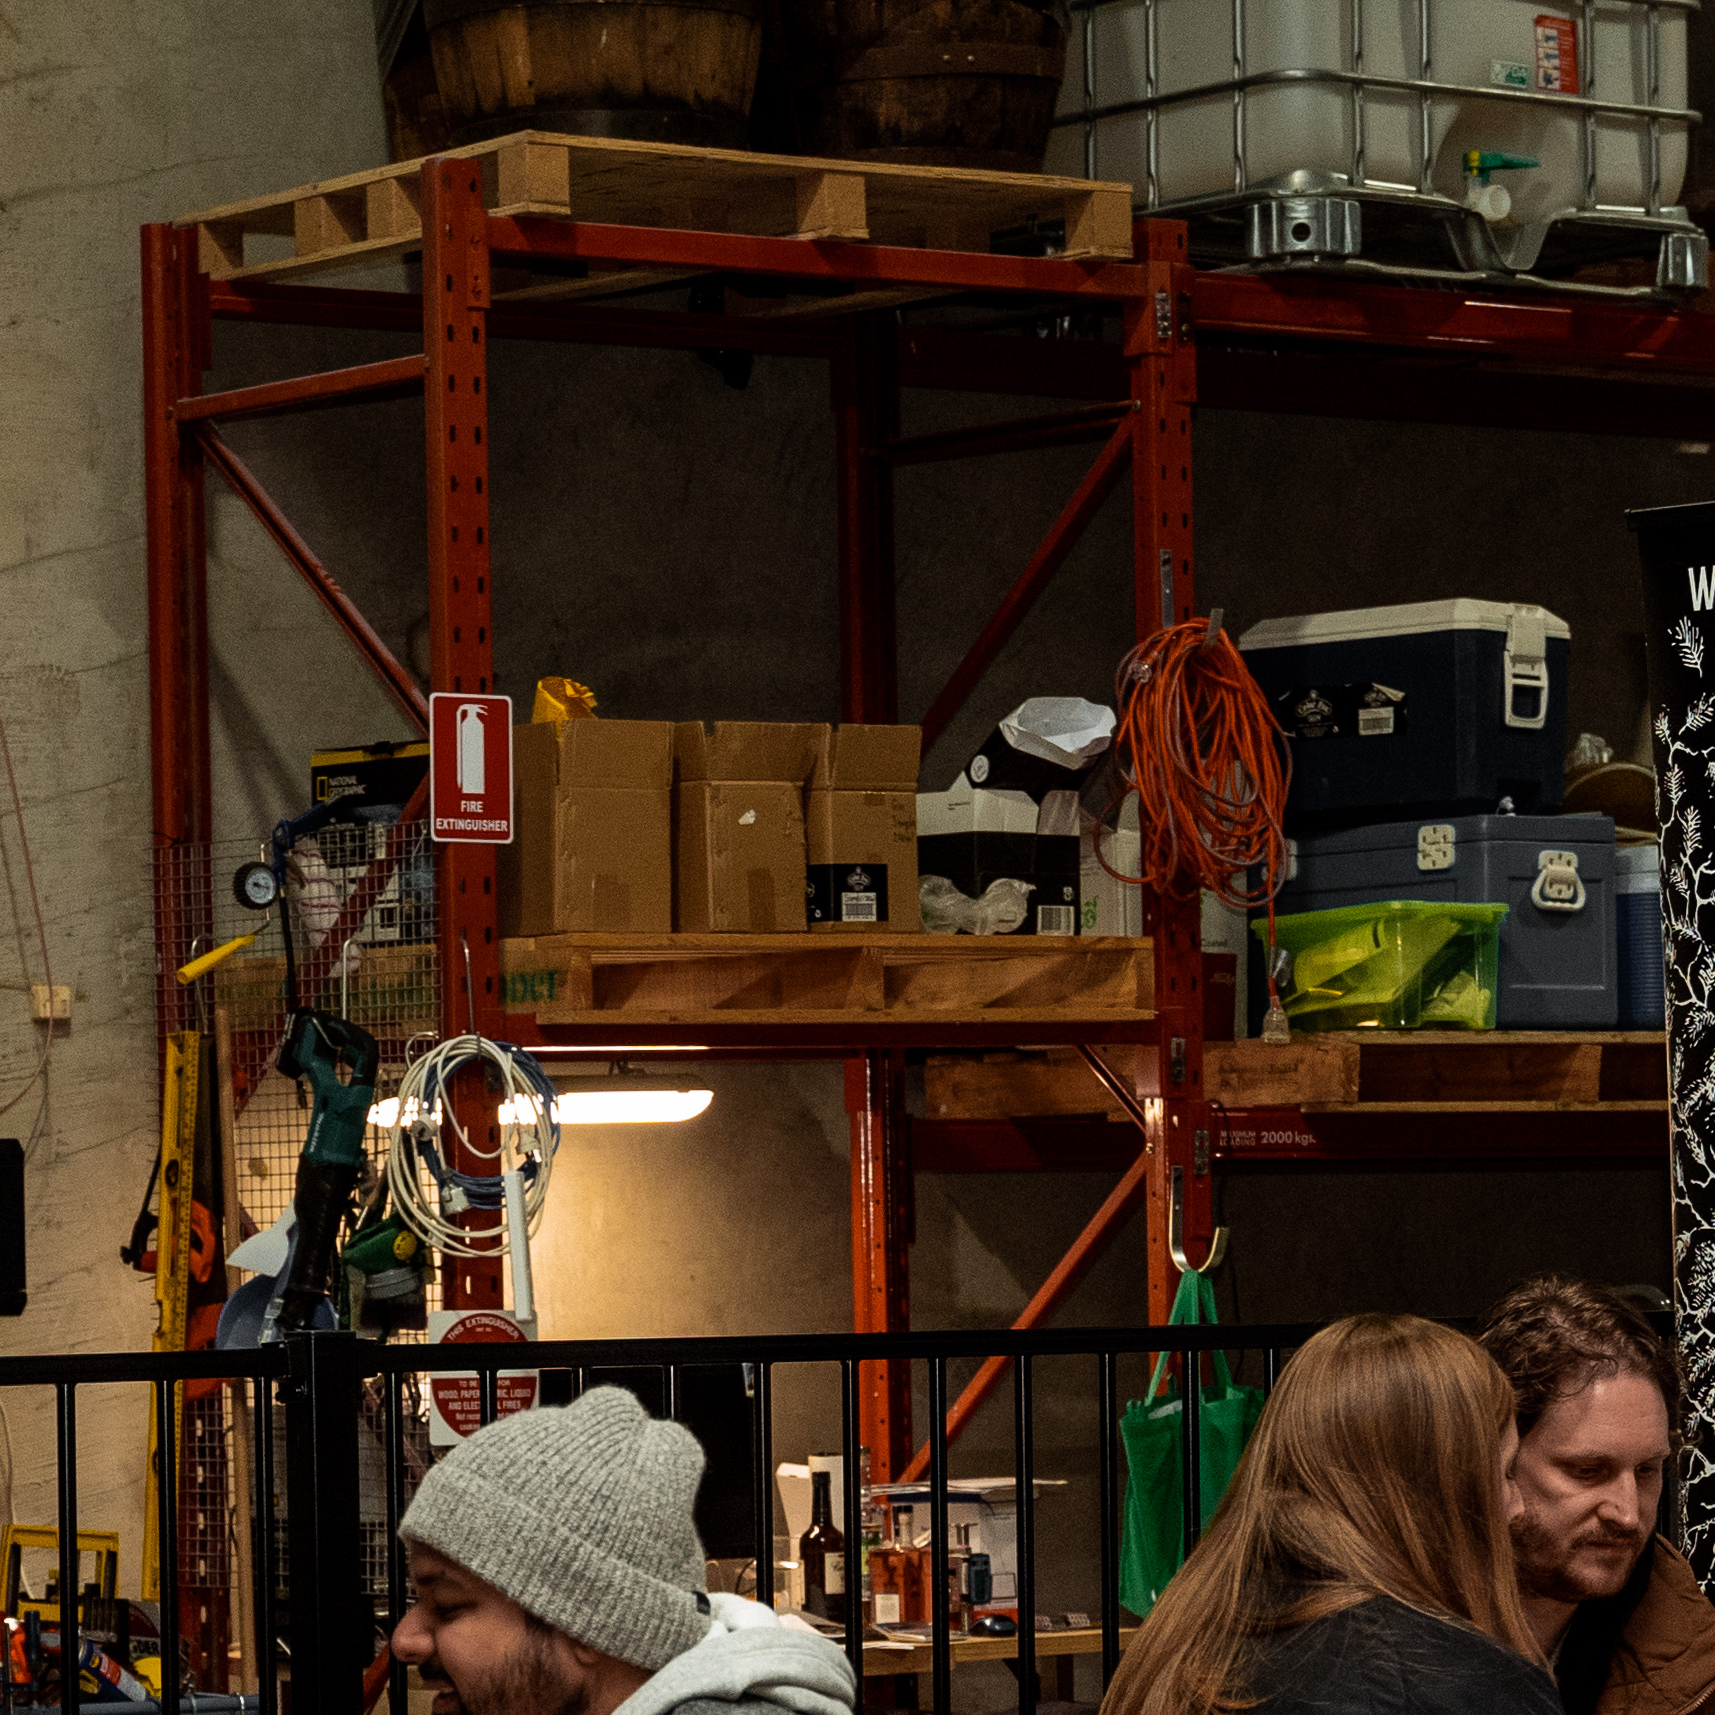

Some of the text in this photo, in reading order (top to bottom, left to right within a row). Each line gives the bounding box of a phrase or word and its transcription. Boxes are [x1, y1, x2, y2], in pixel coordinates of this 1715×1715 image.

[460, 800, 484, 813] FIRE
[436, 818, 508, 832] EXTINGUISHER
[1261, 1131, 1292, 1143] 2000
[447, 1316, 519, 1340] THIS EXTINGUISHER
[448, 1402, 462, 1410] AND
